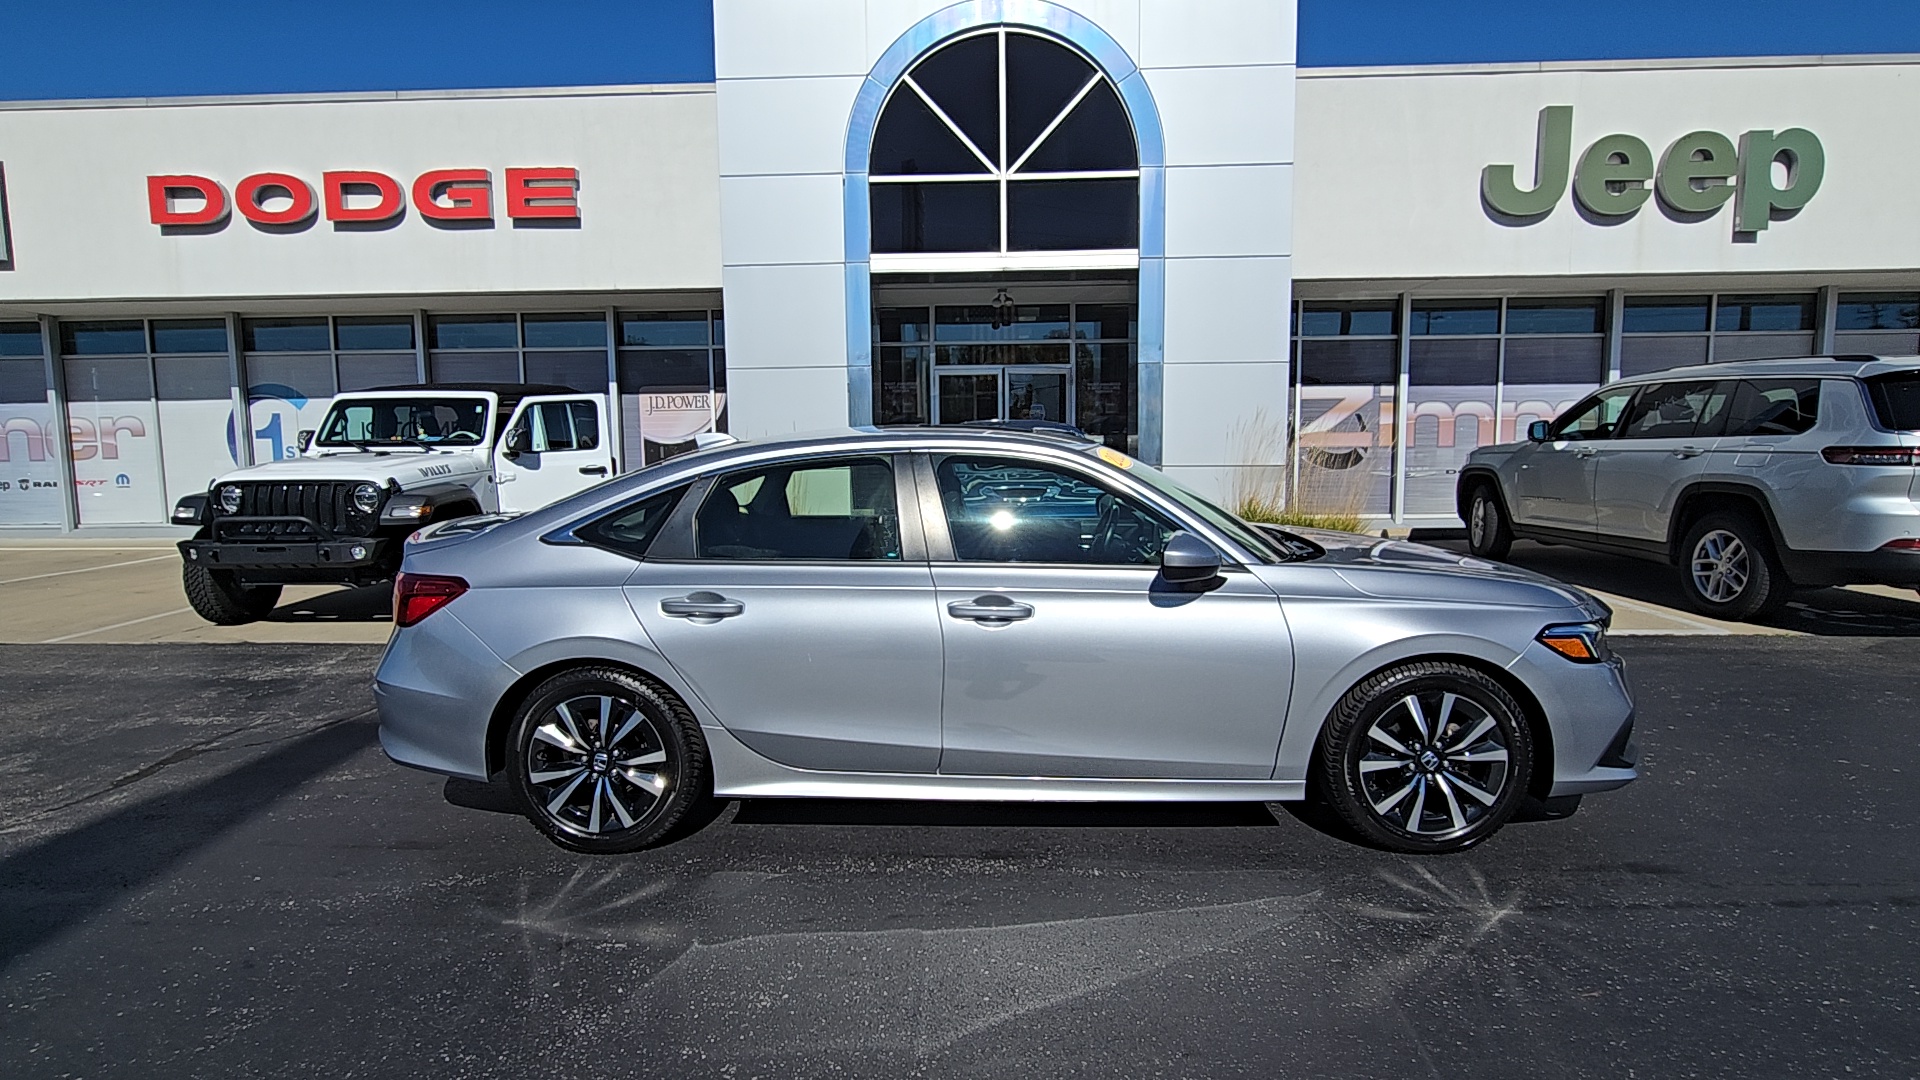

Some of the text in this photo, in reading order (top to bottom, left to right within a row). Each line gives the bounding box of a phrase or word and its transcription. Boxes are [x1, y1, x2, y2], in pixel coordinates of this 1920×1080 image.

[1482, 105, 1824, 231] Jeep
[147, 167, 579, 226] DODGE
[667, 394, 711, 409] POWER
[417, 464, 452, 477] WILLYS
